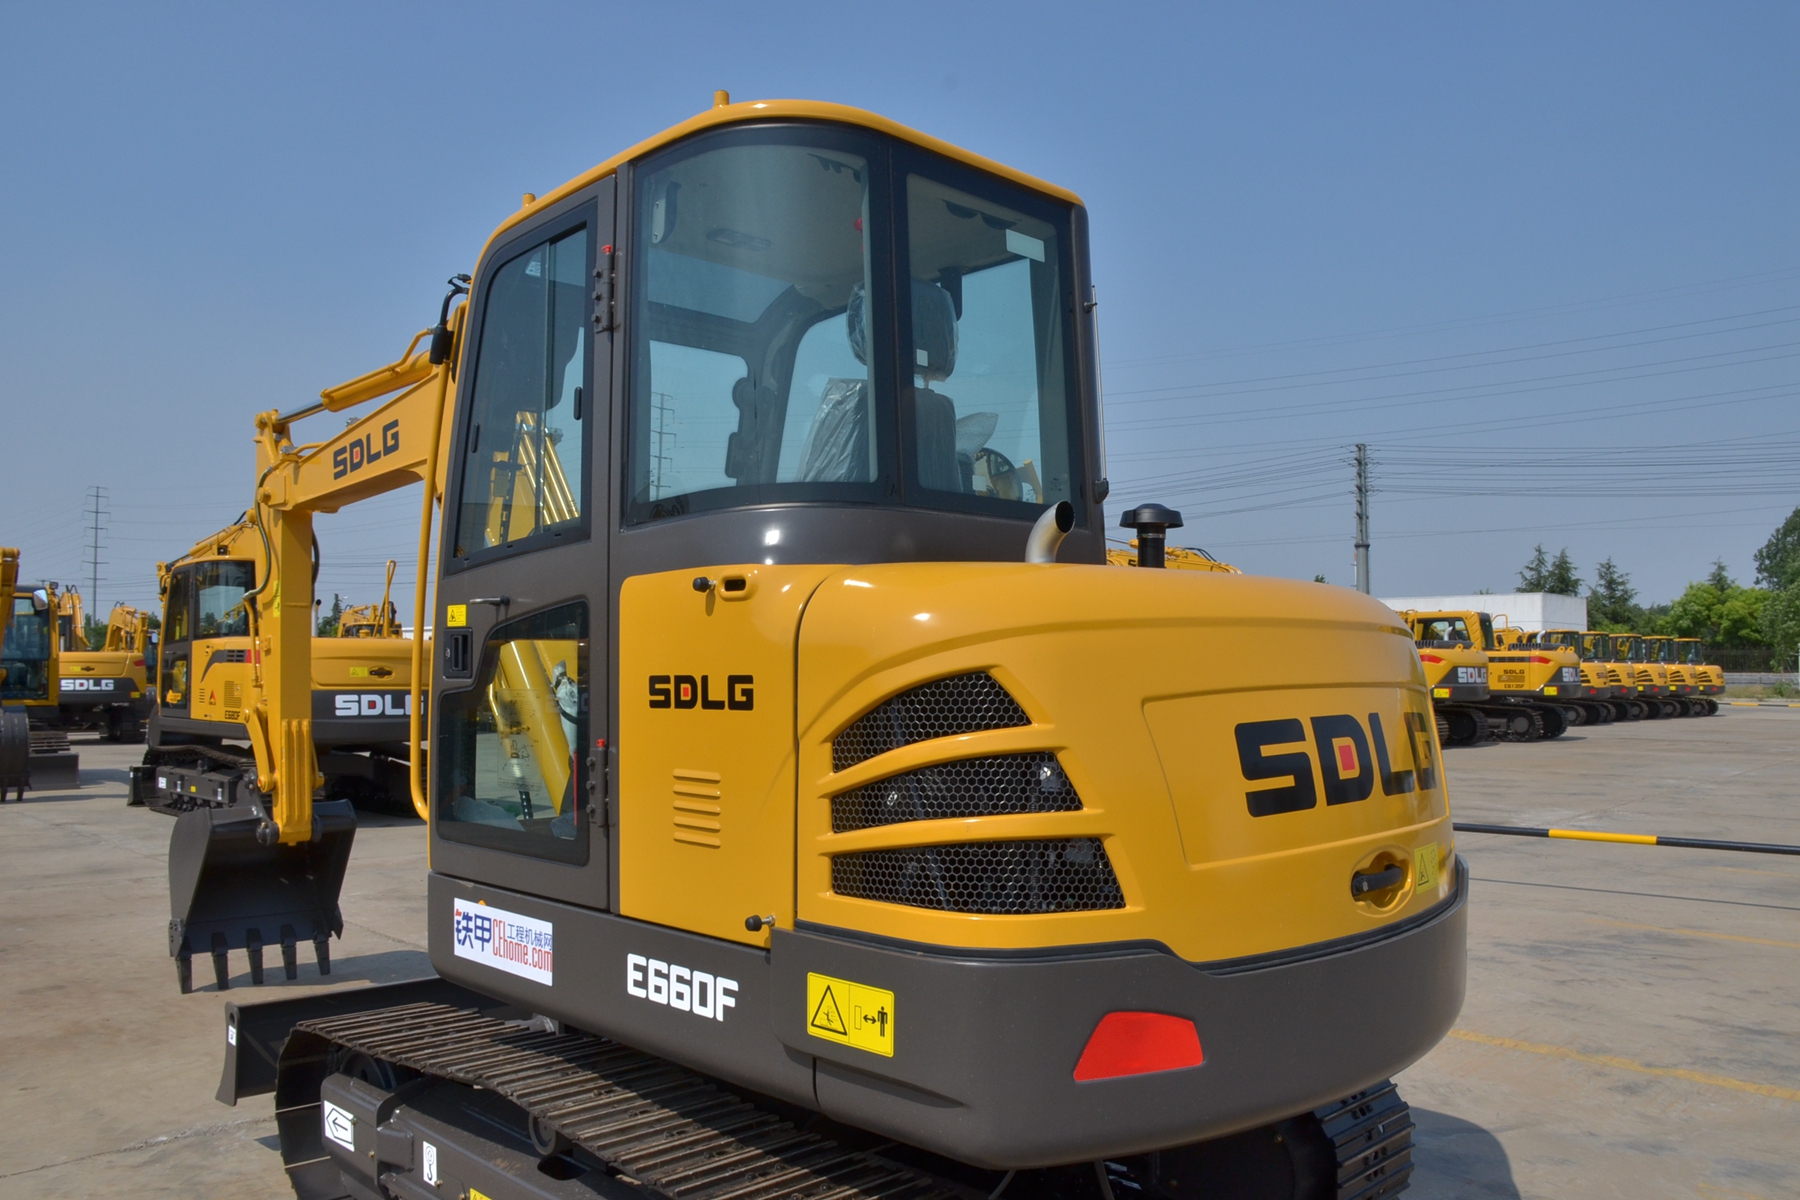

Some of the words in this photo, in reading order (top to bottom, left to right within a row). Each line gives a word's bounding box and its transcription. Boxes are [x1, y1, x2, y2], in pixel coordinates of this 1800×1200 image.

[333, 419, 399, 480] SDLG
[60, 679, 114, 691] SDLG
[1457, 667, 1487, 683] SDLG
[1562, 667, 1580, 682] SDL
[649, 675, 754, 711] SDLG
[1234, 712, 1437, 818] SDLG
[493, 918, 552, 973] CEhome.com
[507, 923, 552, 950] 工程机械网
[627, 953, 739, 1022] E660F
